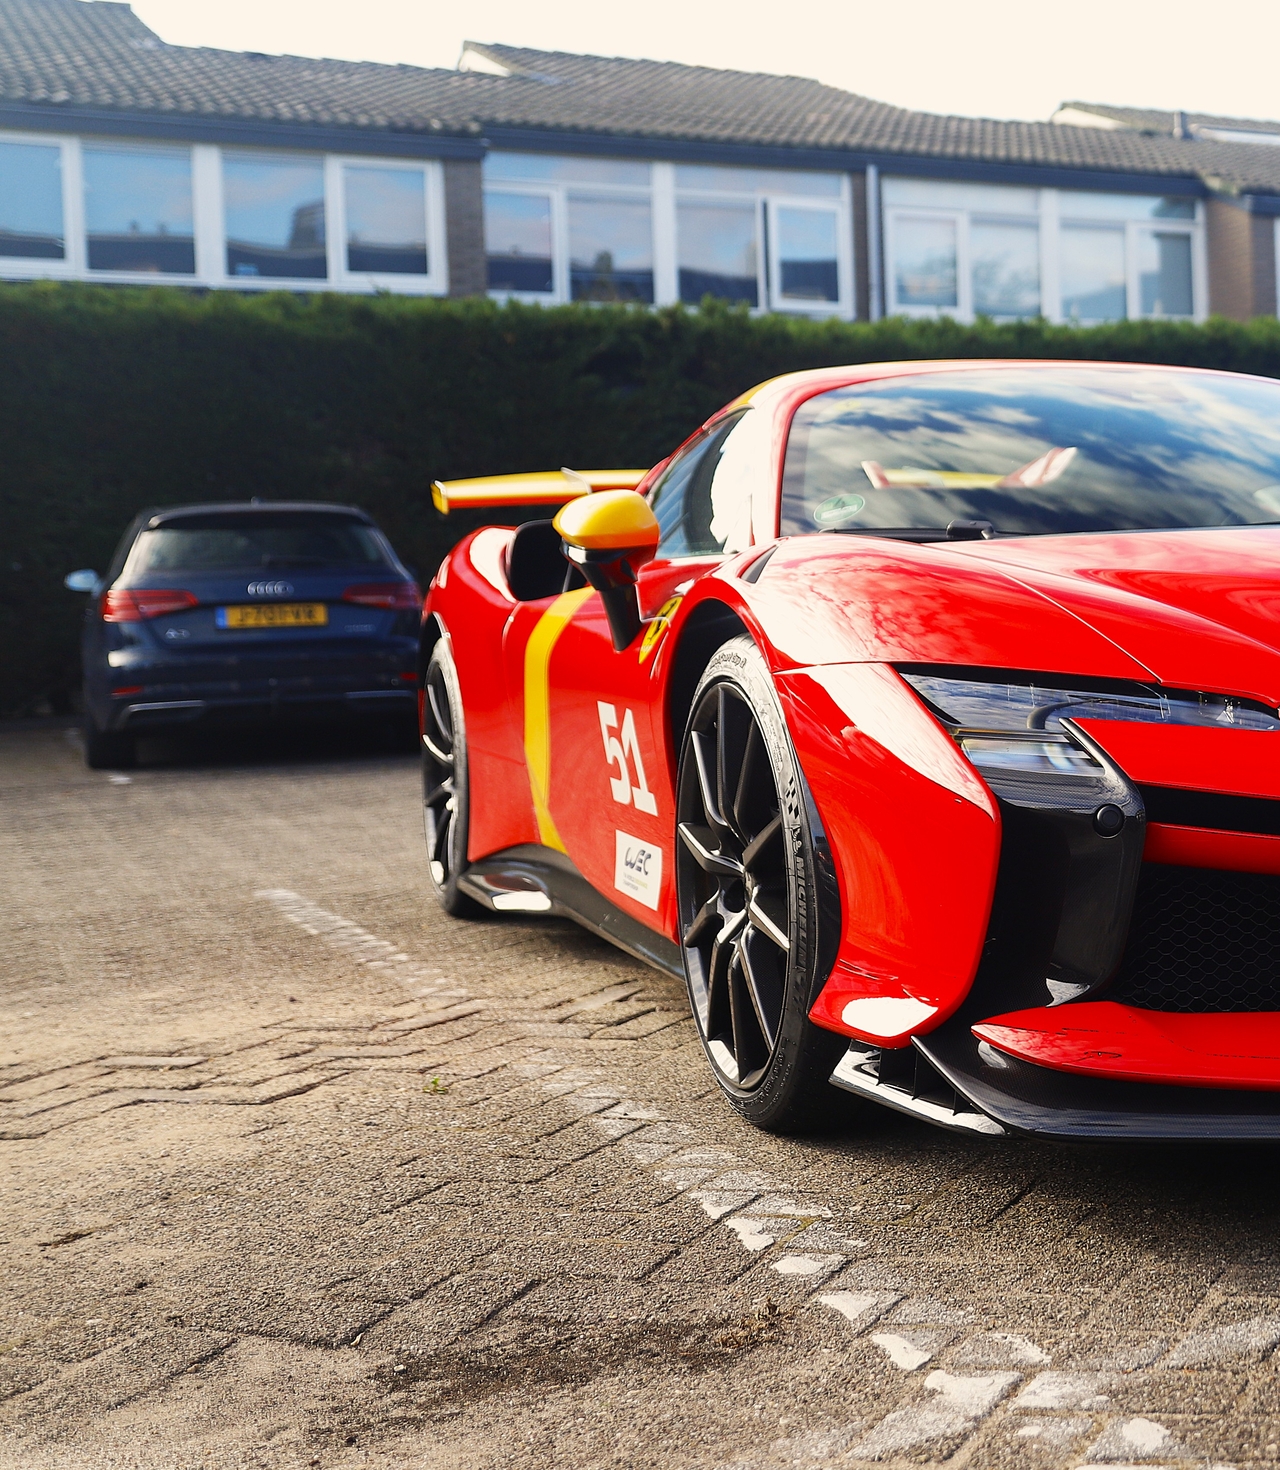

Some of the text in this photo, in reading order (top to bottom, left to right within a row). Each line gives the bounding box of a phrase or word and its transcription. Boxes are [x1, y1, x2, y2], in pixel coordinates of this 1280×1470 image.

[596, 700, 659, 817] 51
[624, 846, 652, 876] WEC
[795, 856, 808, 967] MICHELIN
